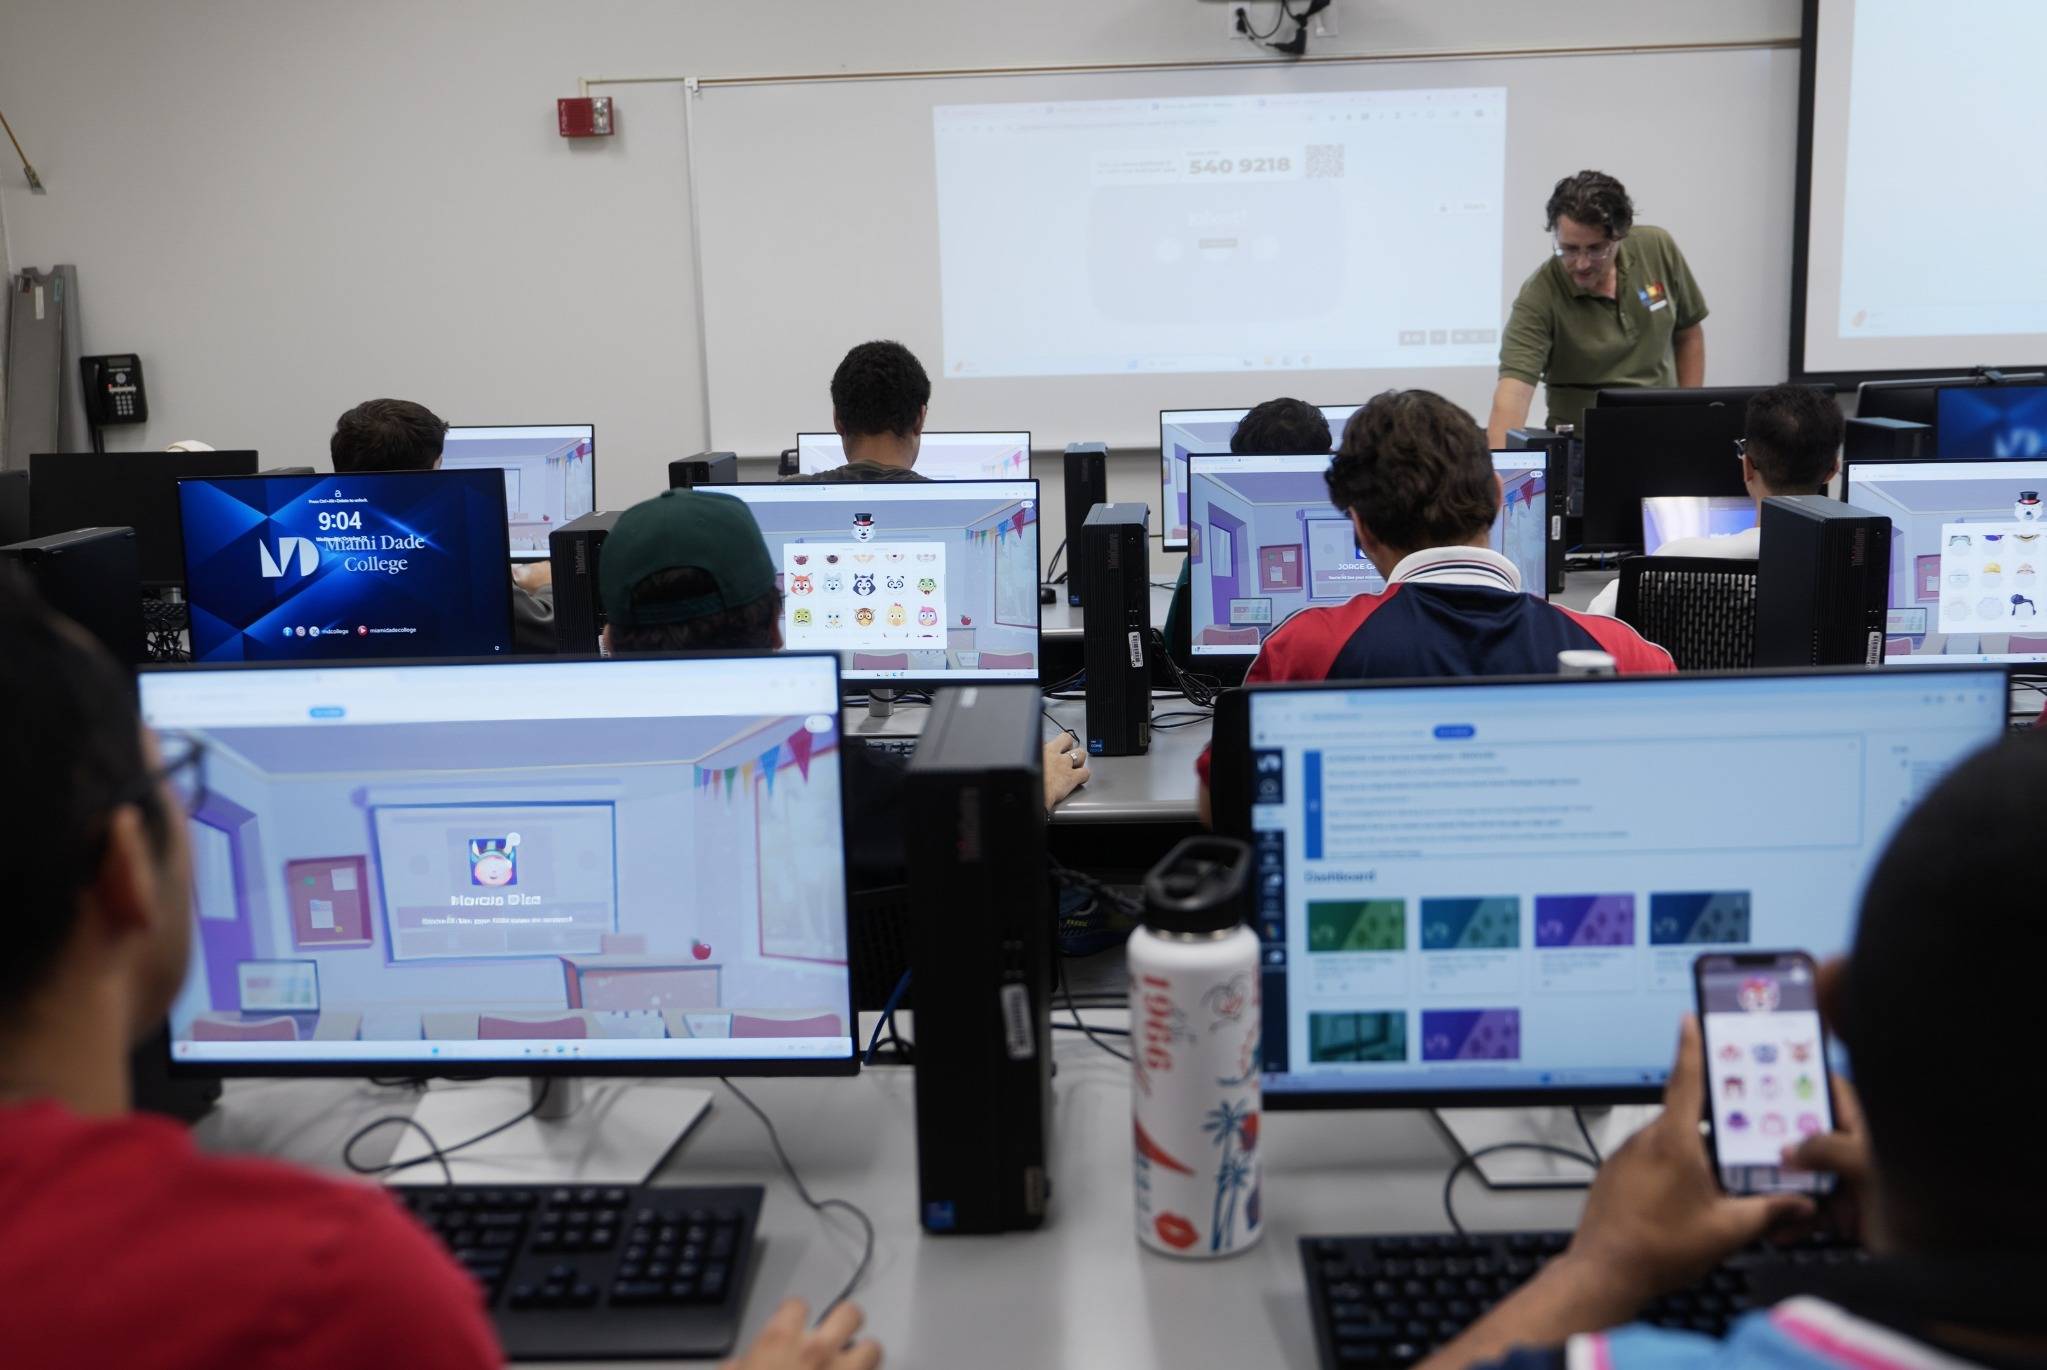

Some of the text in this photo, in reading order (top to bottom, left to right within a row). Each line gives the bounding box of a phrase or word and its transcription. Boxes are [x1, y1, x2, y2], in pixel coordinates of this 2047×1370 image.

[1188, 158, 1233, 175] 540
[1238, 156, 1291, 173] 9218
[318, 511, 362, 530] 9:04
[325, 534, 425, 552] Miami Dade
[344, 556, 408, 575] College
